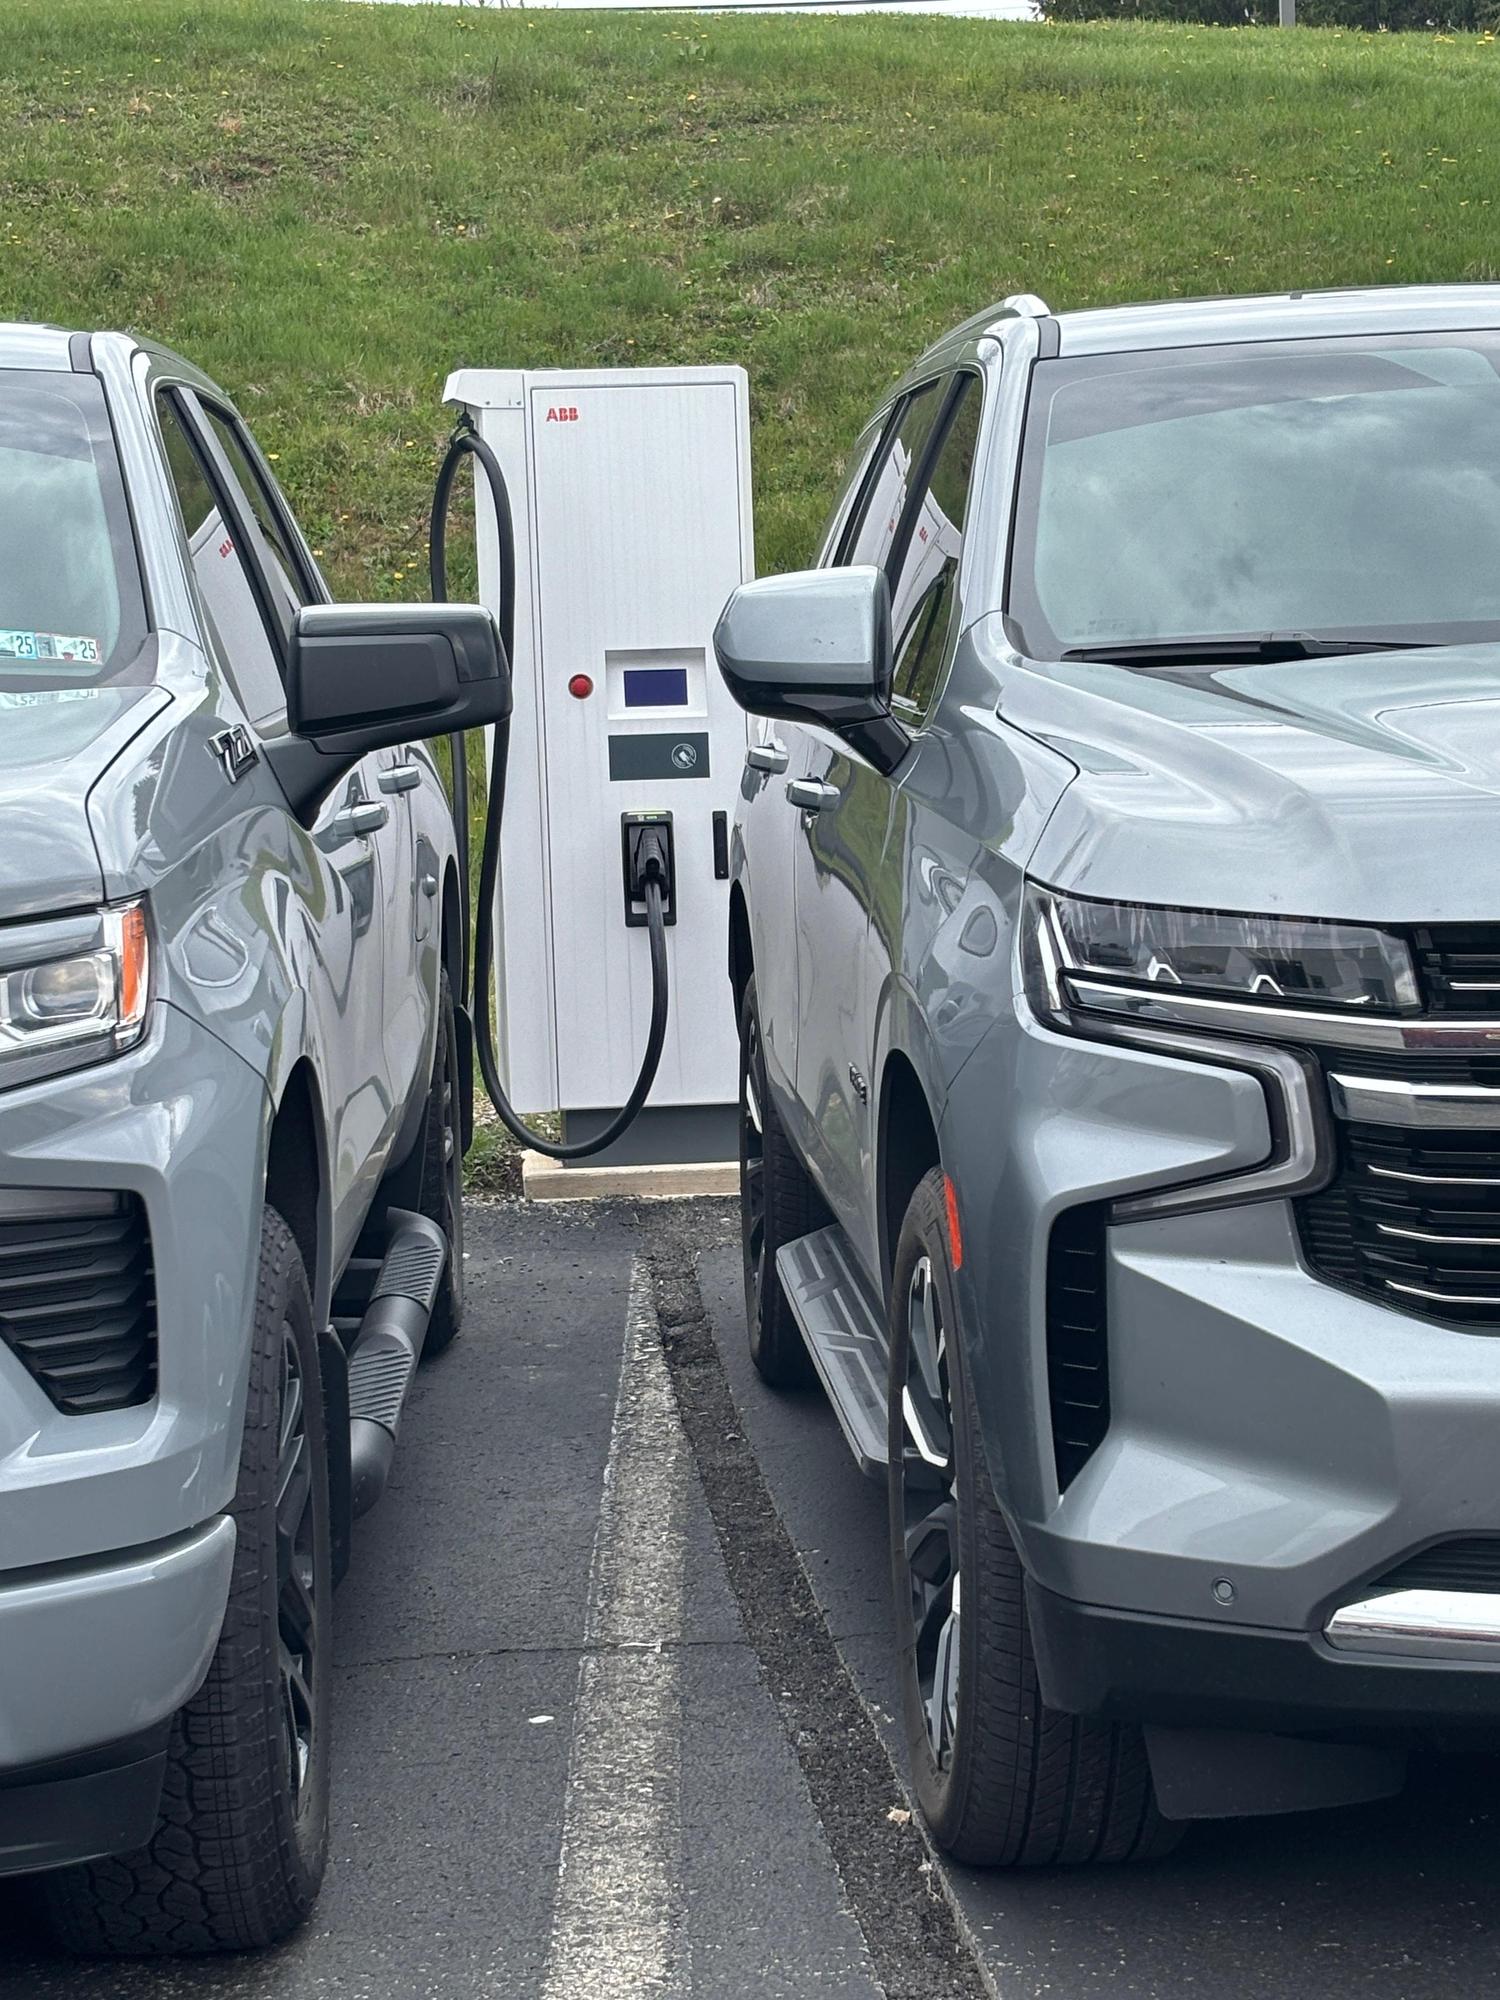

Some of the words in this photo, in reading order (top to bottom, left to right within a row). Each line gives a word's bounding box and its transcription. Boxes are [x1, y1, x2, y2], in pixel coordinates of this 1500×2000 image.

[546, 407, 579, 422] ABB
[15, 635, 33, 655] 25
[80, 640, 96, 660] 25
